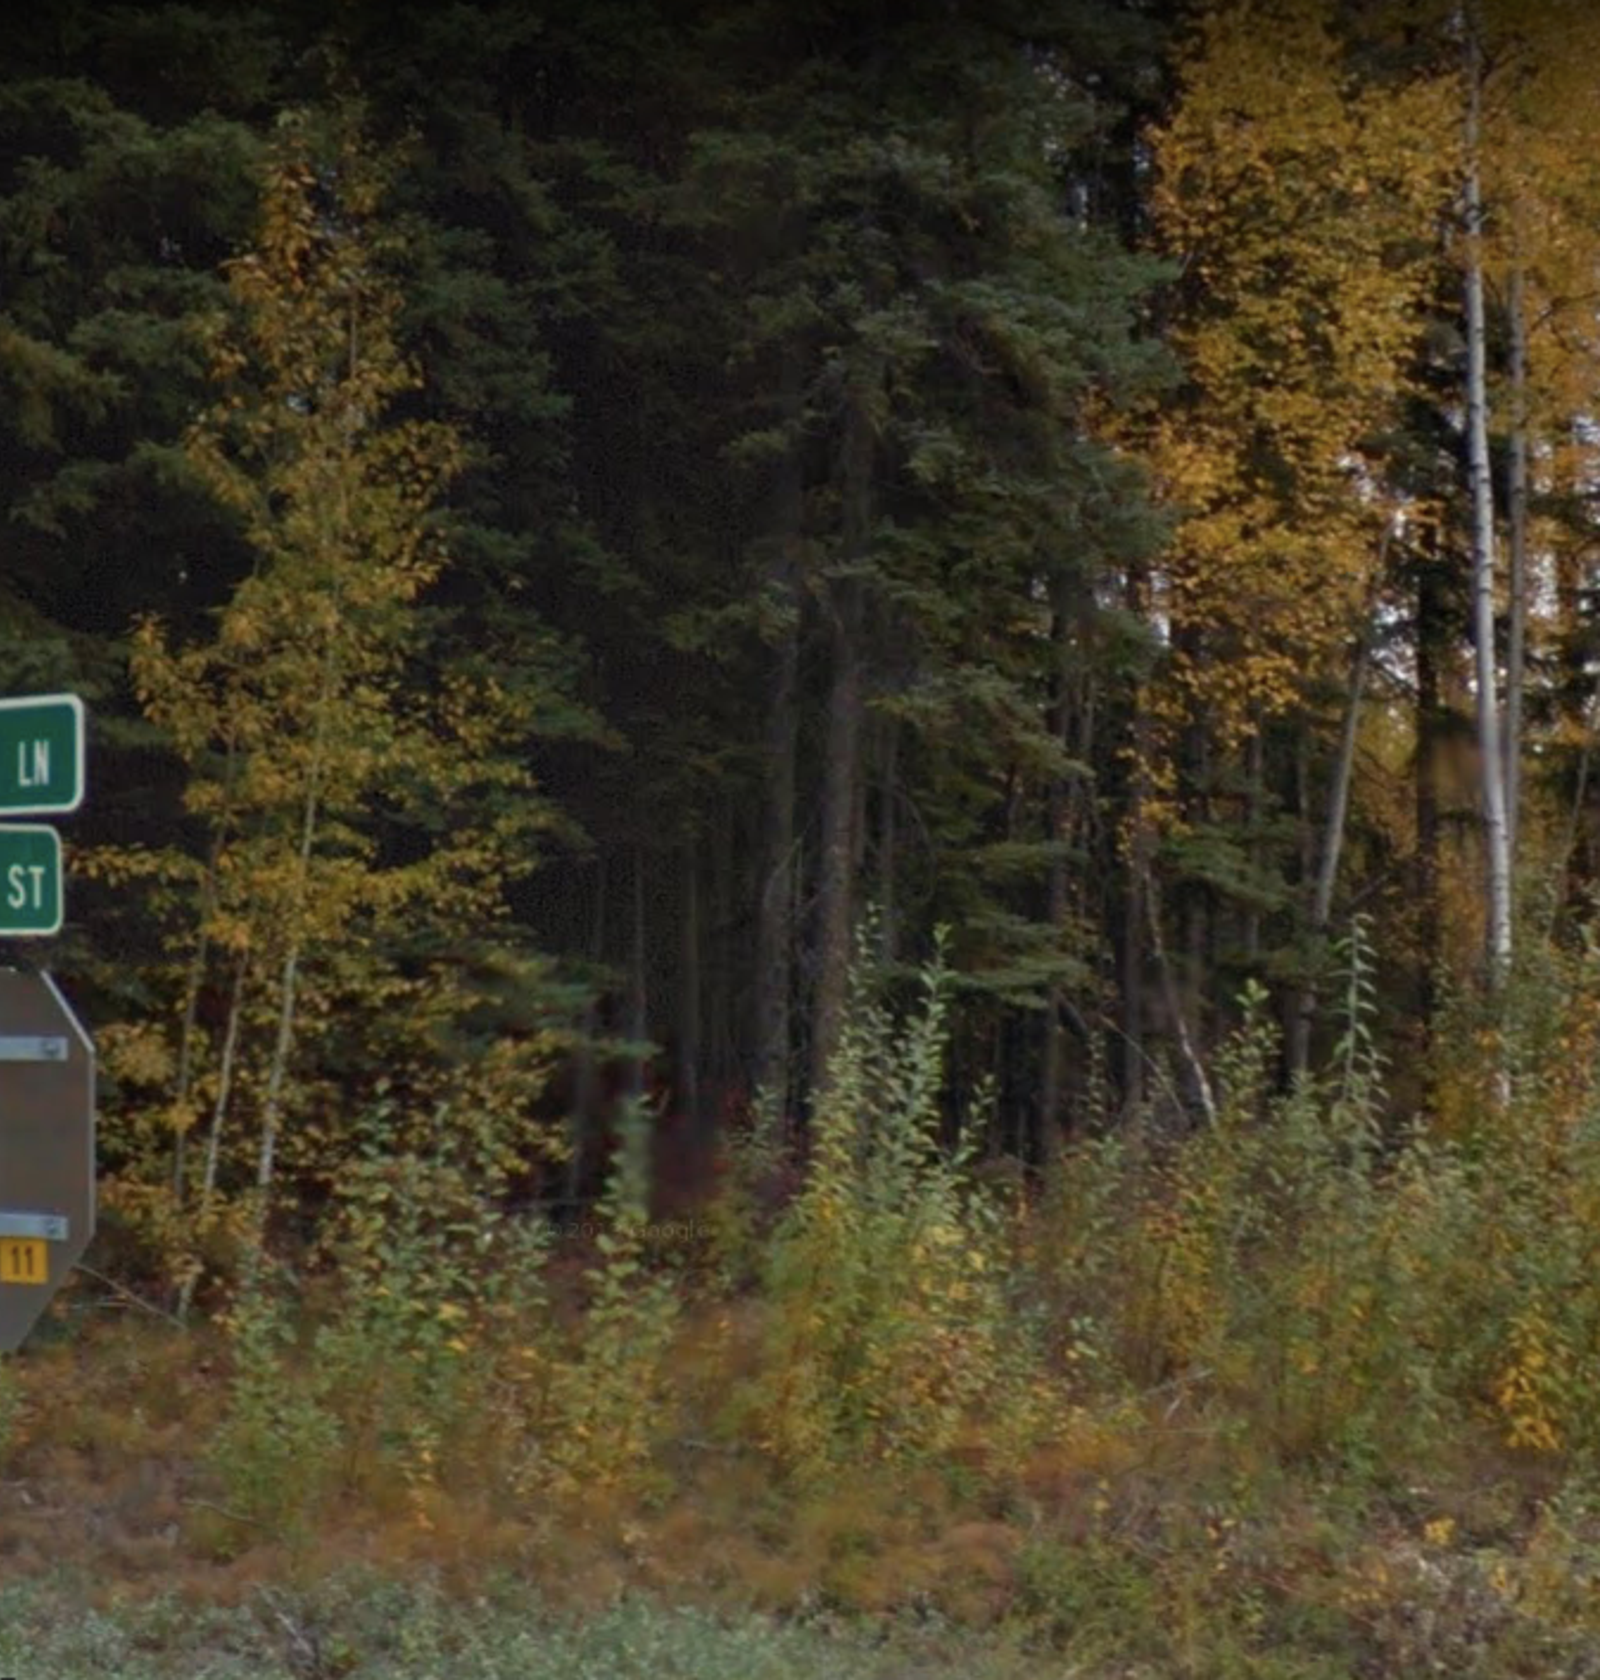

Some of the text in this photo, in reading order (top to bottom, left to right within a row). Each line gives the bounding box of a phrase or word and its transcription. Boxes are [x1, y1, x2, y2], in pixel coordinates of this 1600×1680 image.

[17, 739, 49, 787] LN
[8, 864, 45, 910] ST
[12, 1245, 33, 1276] 11
